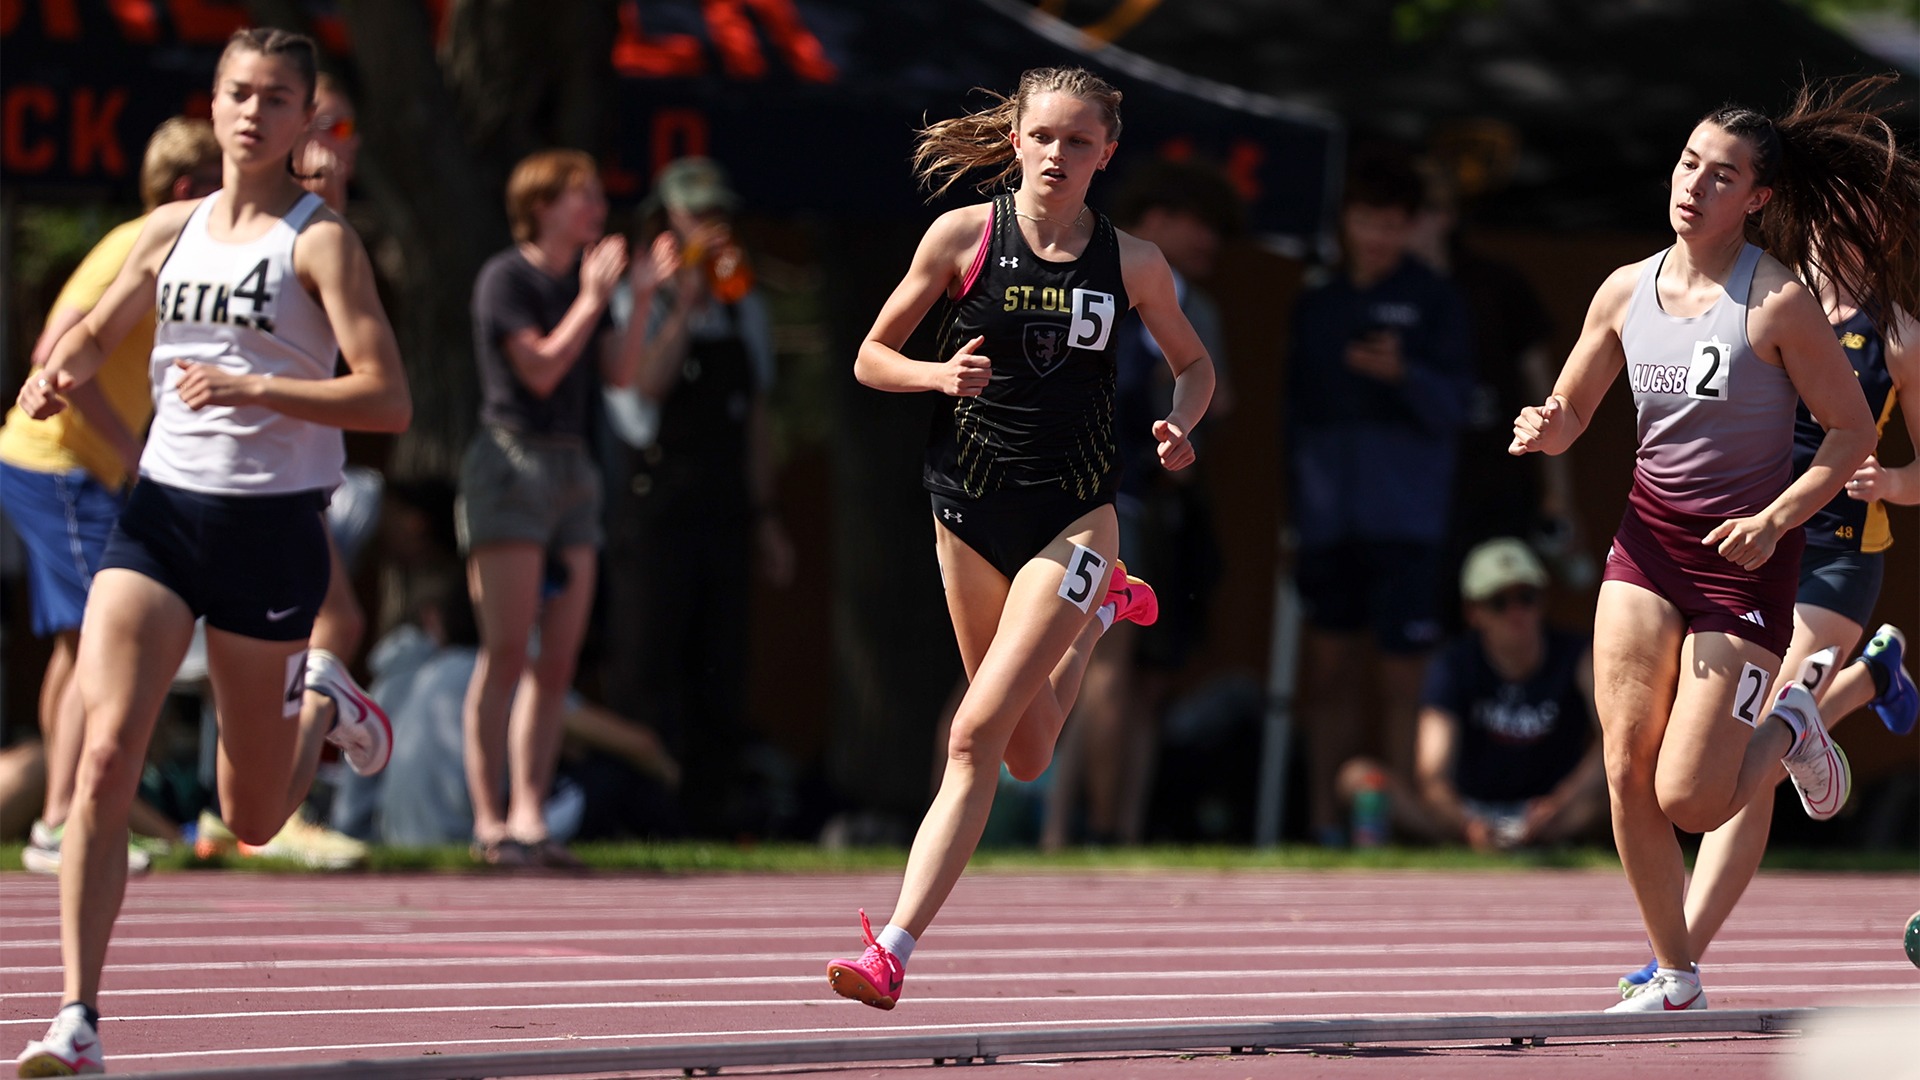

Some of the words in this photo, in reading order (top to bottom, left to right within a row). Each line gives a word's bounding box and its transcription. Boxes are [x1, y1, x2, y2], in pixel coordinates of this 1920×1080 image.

[160, 281, 275, 333] BETH
[233, 257, 272, 313] 4
[1003, 285, 1036, 312] ST.
[1041, 286, 1073, 314] OL
[1076, 293, 1105, 347] 5
[1695, 345, 1721, 398] 2
[1834, 525, 1853, 538] 48
[1066, 550, 1102, 604] 5
[1738, 669, 1763, 723] 2
